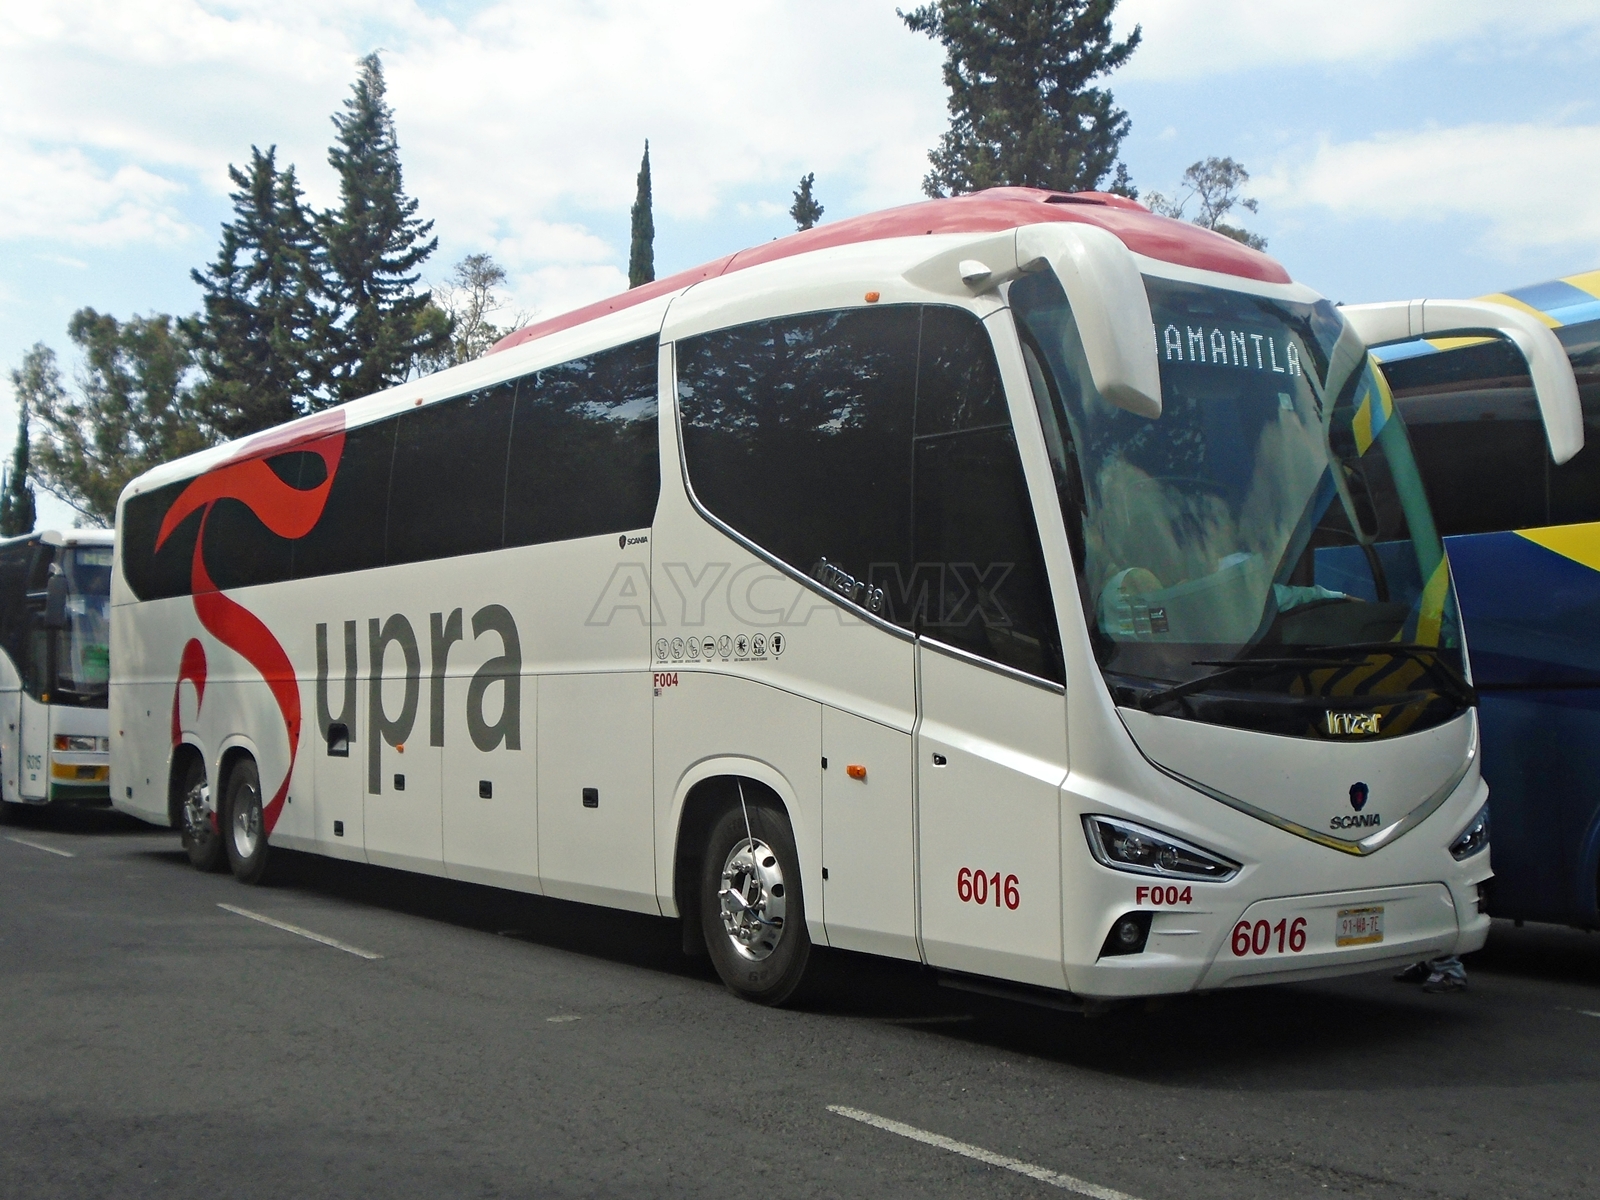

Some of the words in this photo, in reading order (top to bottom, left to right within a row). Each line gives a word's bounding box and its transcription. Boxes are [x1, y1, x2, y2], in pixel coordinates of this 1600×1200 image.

[1153, 324, 1301, 377] AMANTLA
[627, 536, 648, 546] SCANIA
[864, 583, 884, 612] i8
[653, 672, 679, 688] F004
[1326, 710, 1382, 734] Irizar
[1330, 814, 1381, 829] SCANIA
[957, 866, 1020, 911] 6016
[1135, 886, 1193, 905] F004
[1231, 916, 1308, 957] 6016
